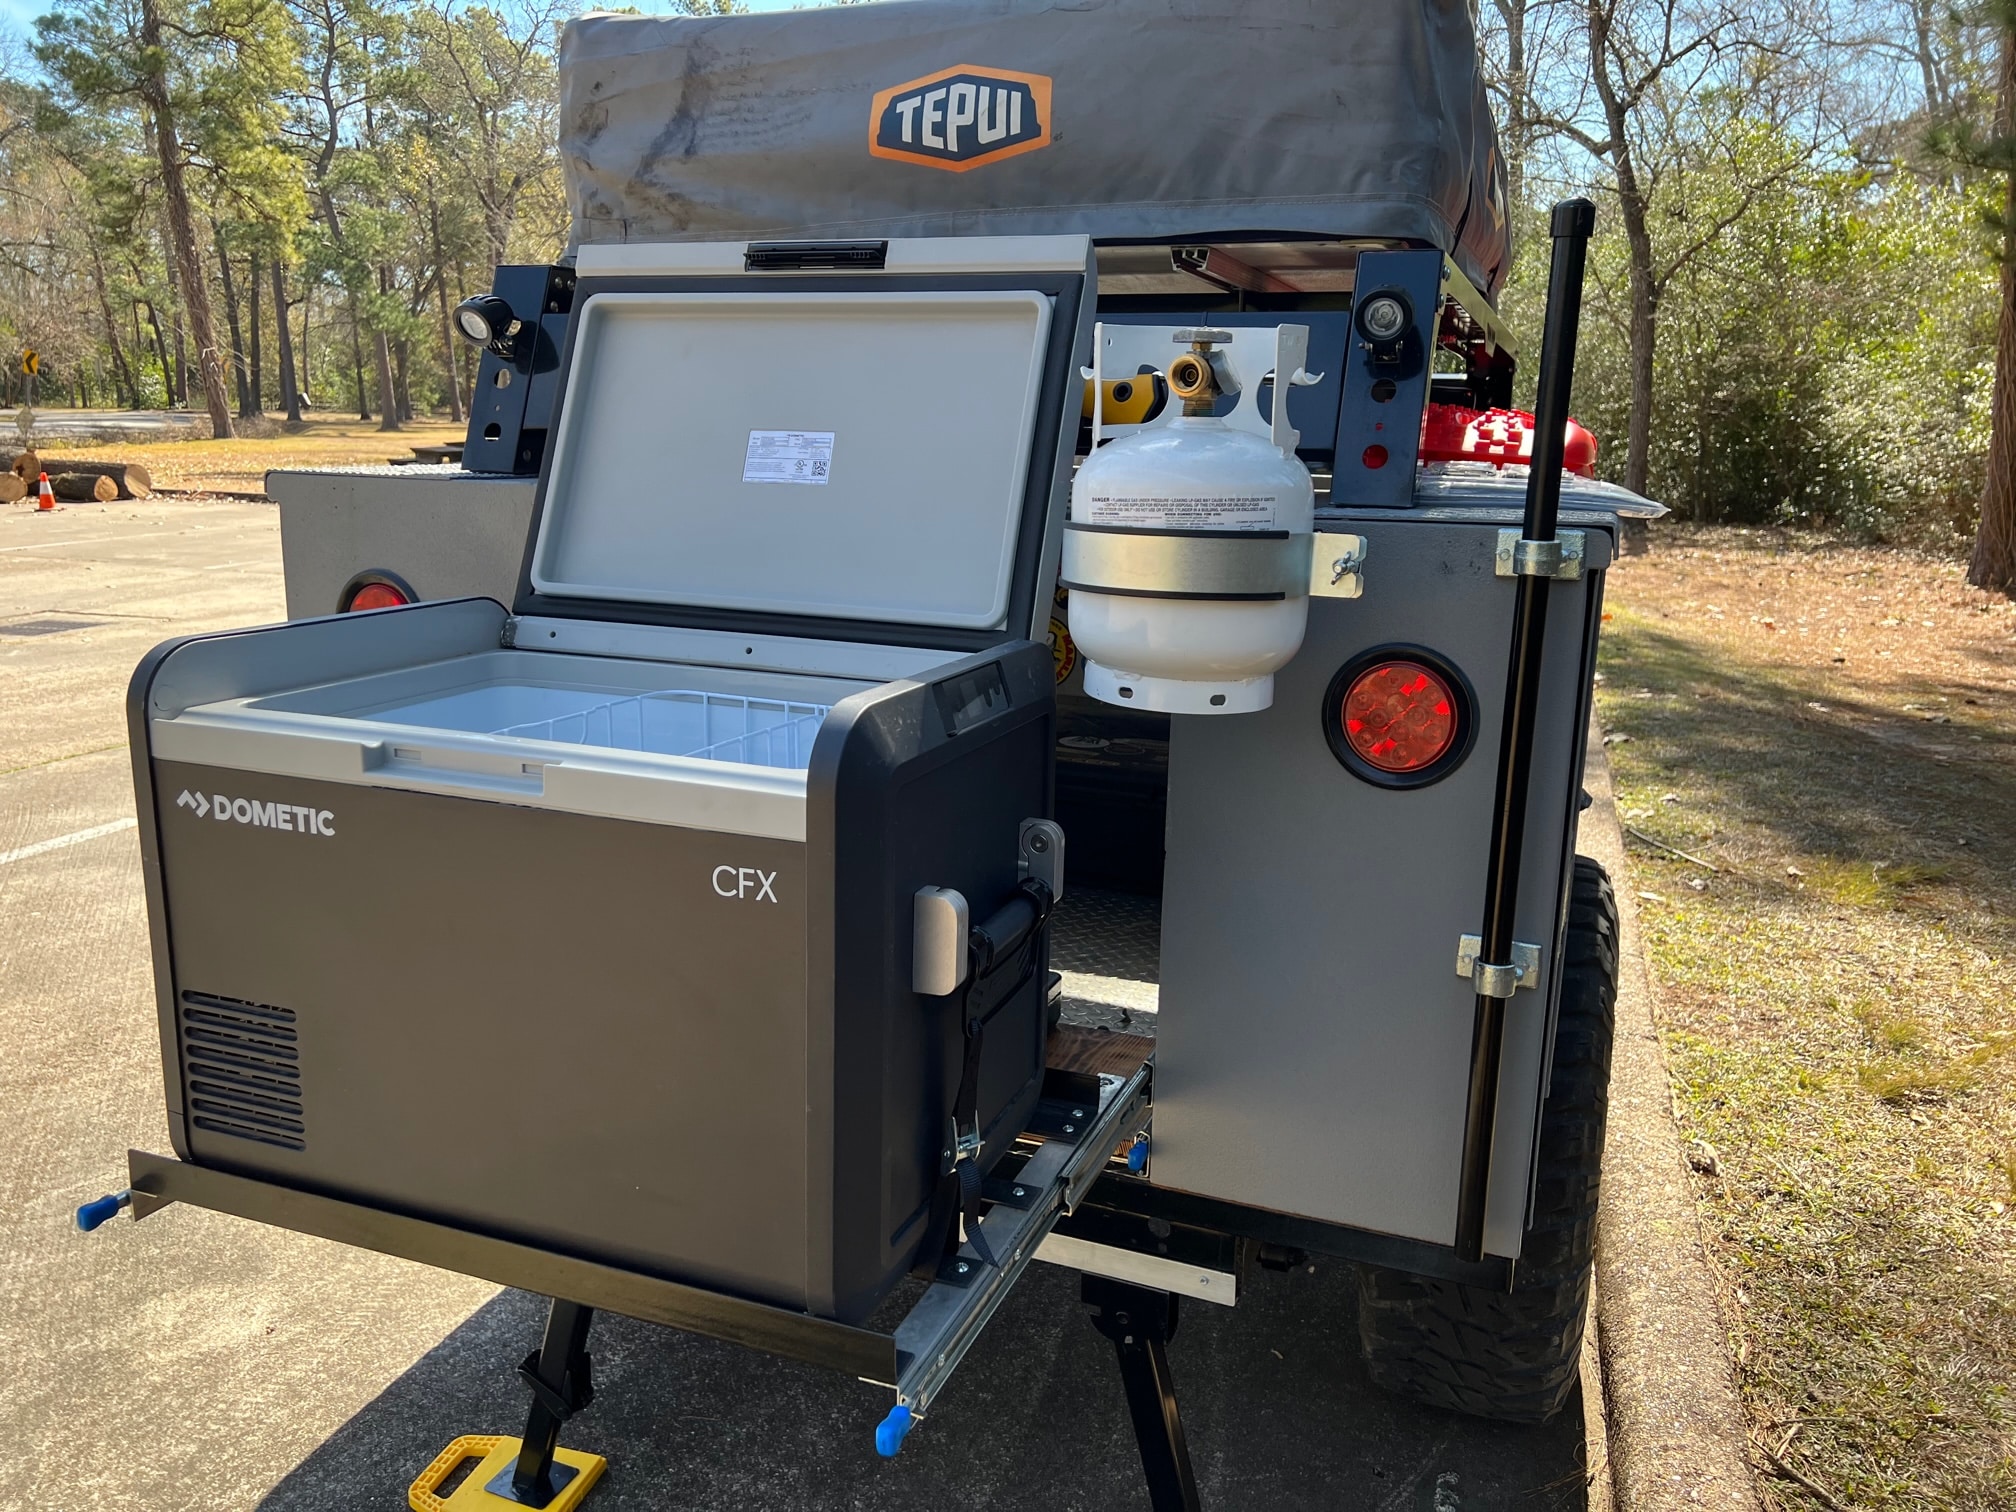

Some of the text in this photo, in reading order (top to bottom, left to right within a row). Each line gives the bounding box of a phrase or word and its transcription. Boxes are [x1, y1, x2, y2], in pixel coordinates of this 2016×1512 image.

[896, 82, 1021, 152] TEPUI
[213, 794, 336, 837] DOMETIC
[712, 865, 778, 903] CFX
